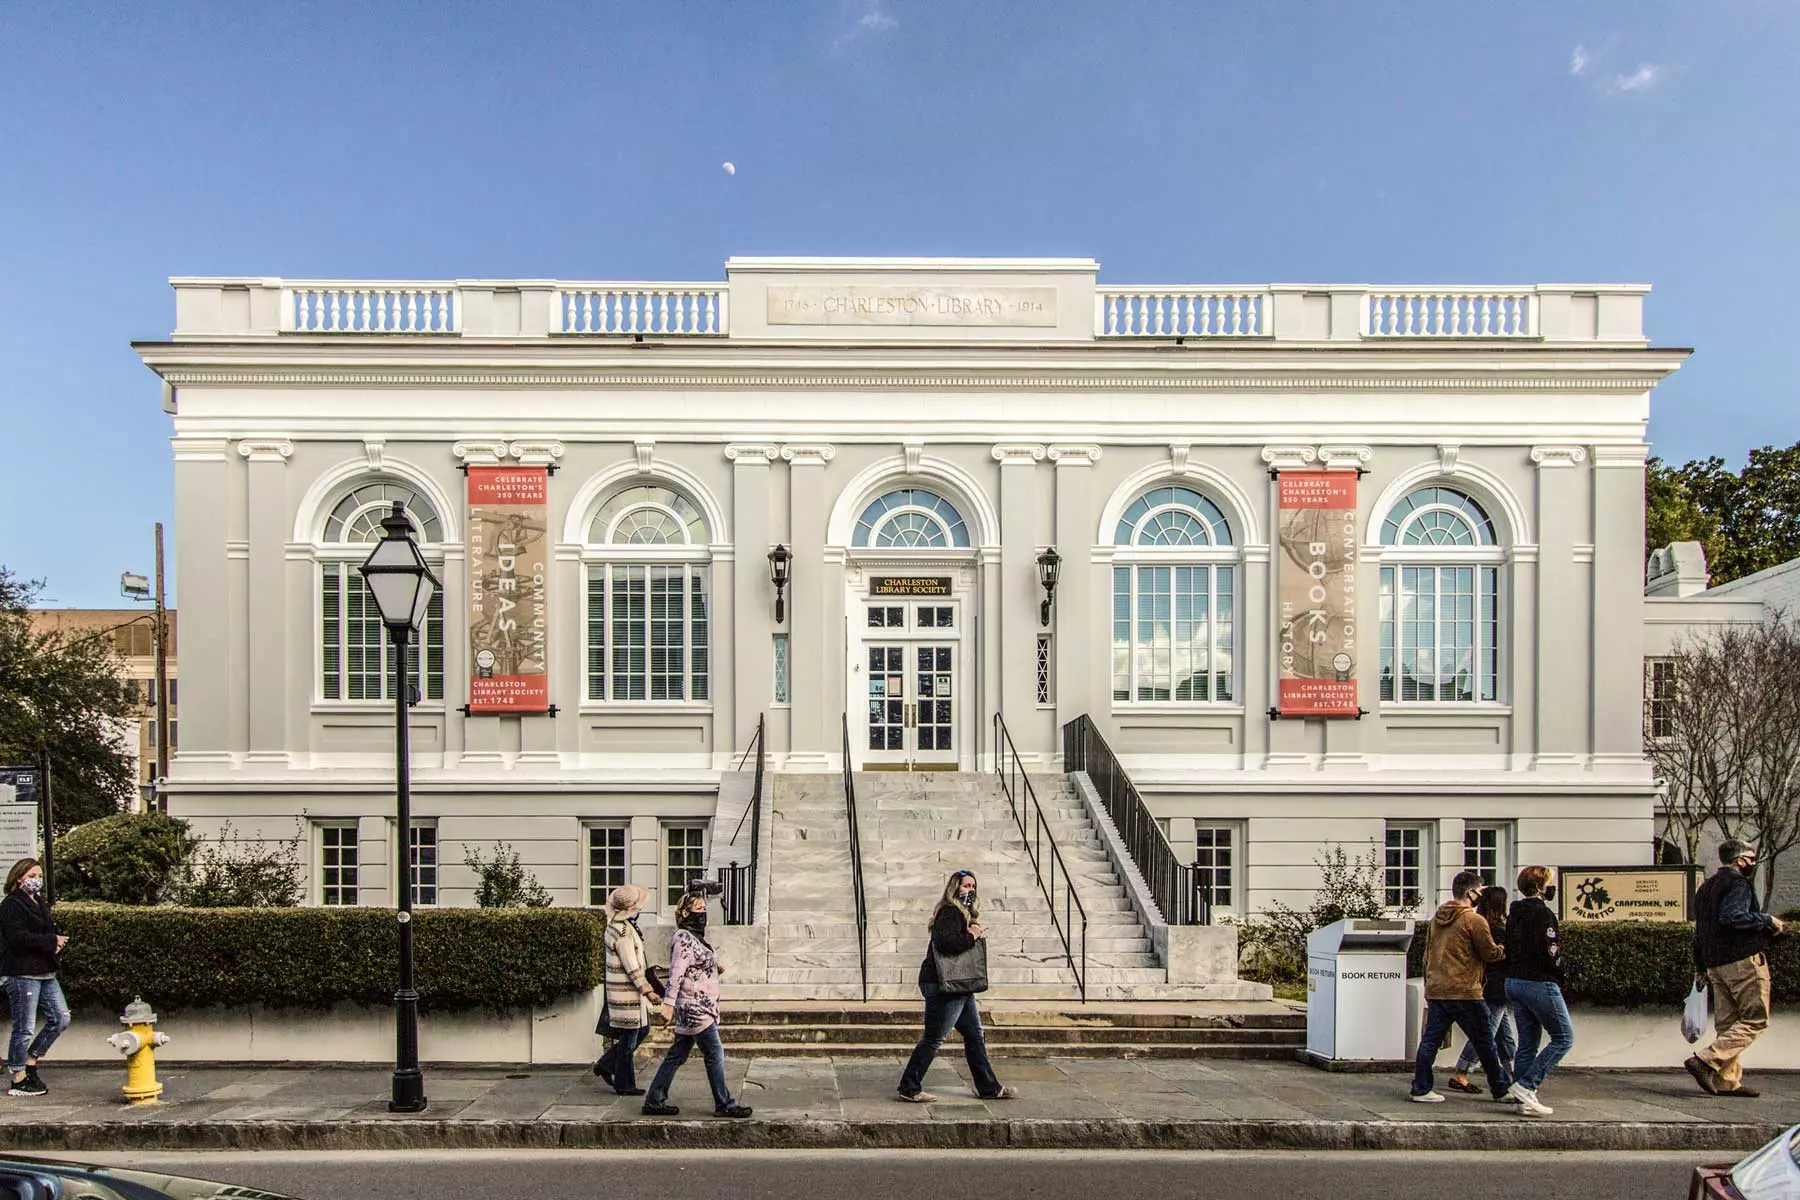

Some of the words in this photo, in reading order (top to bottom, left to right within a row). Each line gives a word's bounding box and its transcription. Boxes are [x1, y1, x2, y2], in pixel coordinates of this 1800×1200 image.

[823, 296, 928, 314] CHARLESTON
[937, 297, 1002, 314] LIBRARY
[471, 508, 483, 612] LITERATURE
[498, 544, 516, 631] IDEAS
[876, 586, 910, 594] LIBRARY
[912, 586, 947, 594] SOCIETY
[1308, 541, 1326, 643] BOOKS
[1343, 512, 1354, 649] CONVERSATION
[533, 562, 545, 671] COMMUNITY
[1282, 602, 1294, 675] HISTORY
[1571, 906, 1615, 919] PALMETTO
[1614, 900, 1662, 908] CRAFTSMEN,
